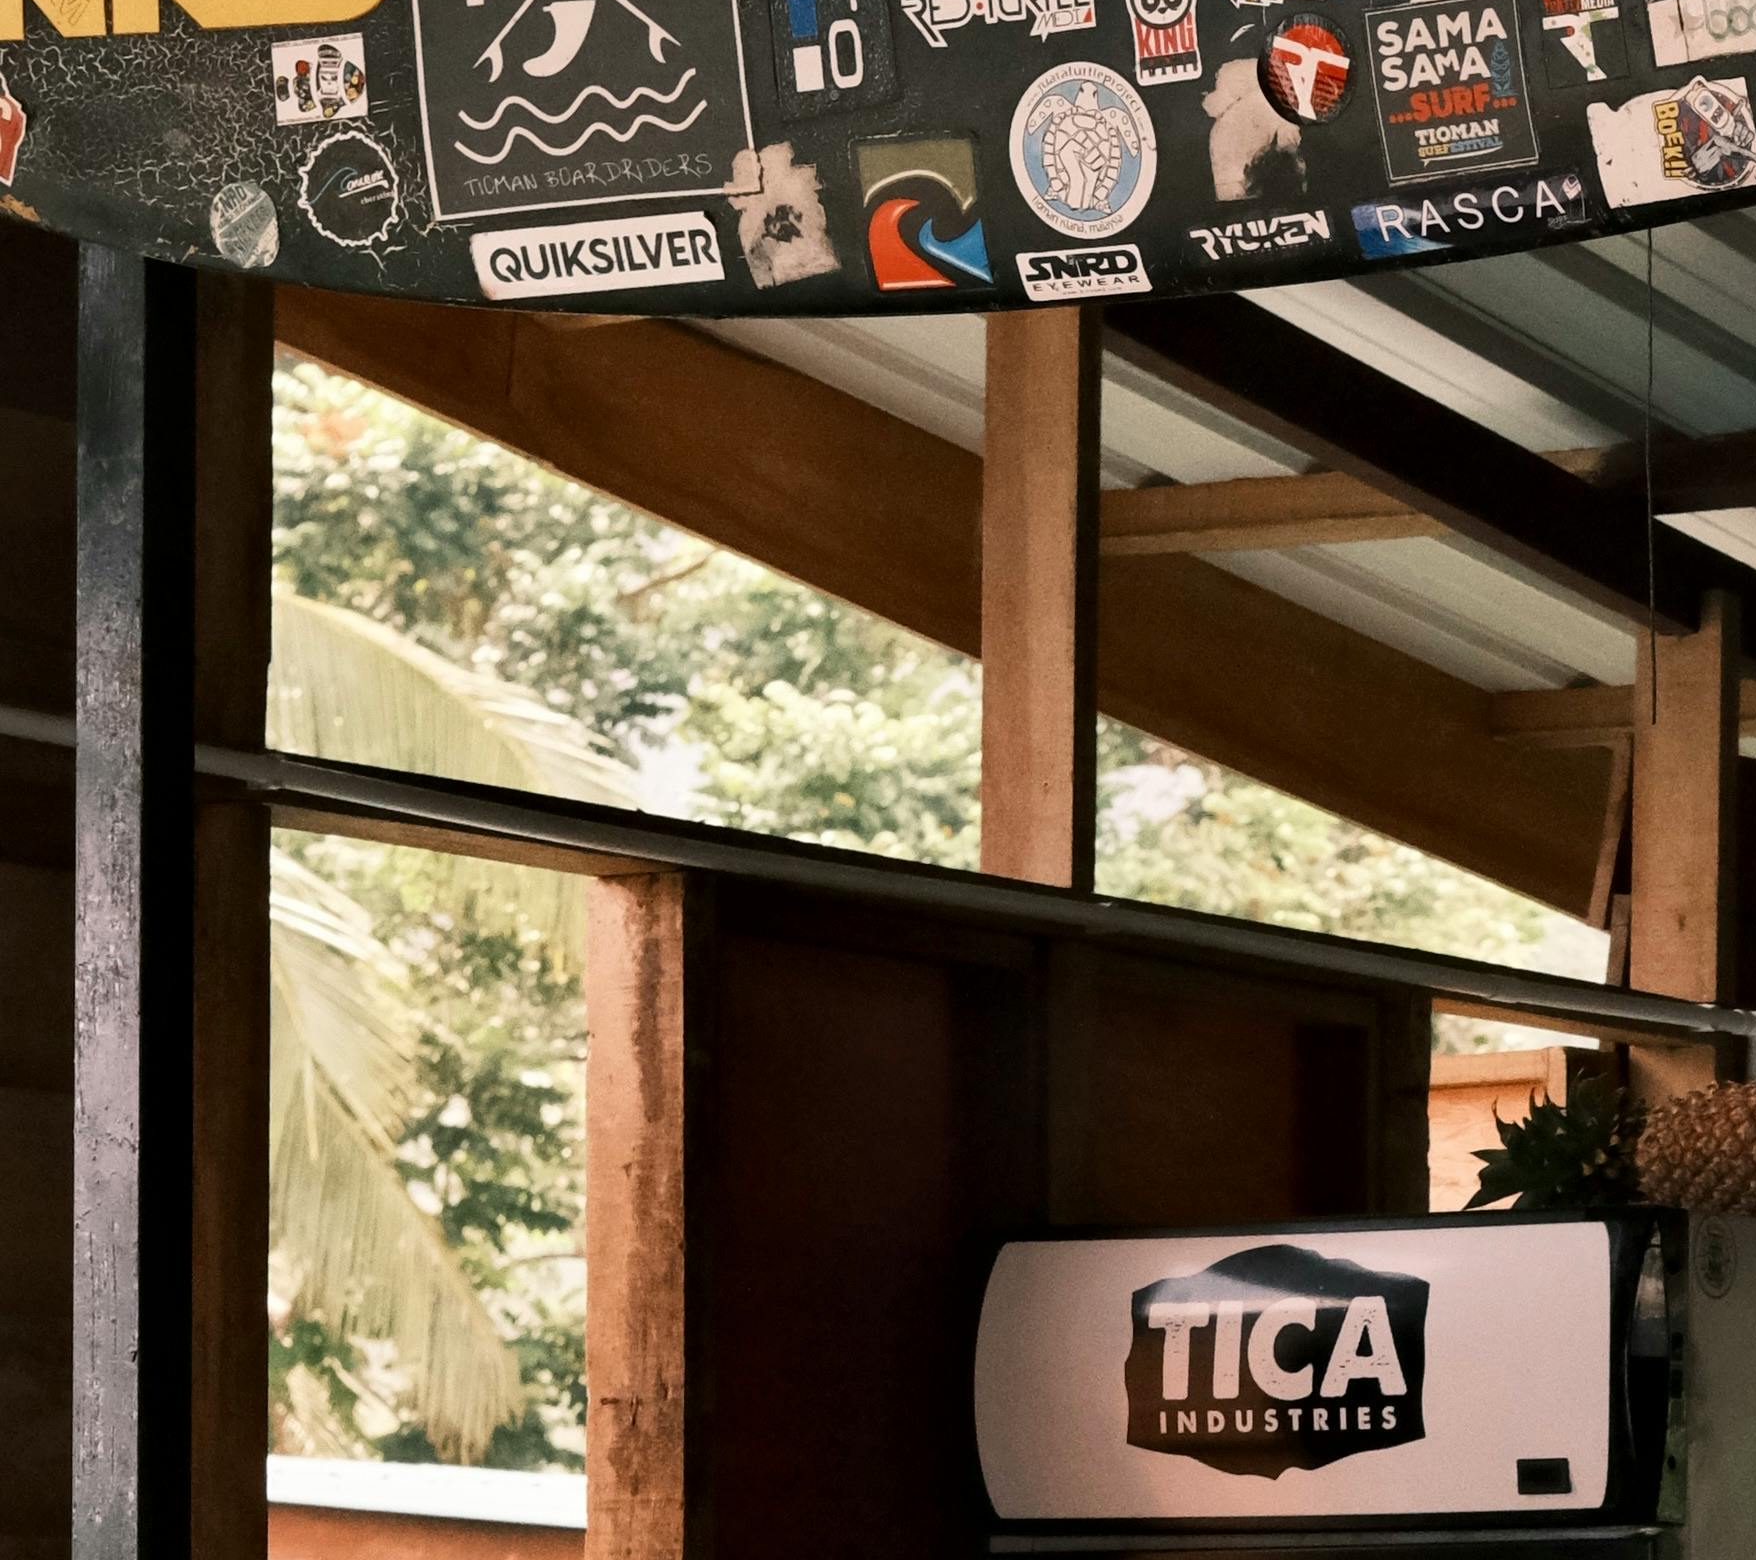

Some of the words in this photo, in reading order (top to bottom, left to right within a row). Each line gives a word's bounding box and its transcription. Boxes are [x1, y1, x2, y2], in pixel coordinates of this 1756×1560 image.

[1135, 11, 1196, 57] KING
[1376, 7, 1508, 57] SAMA
[1381, 46, 1492, 92] SAMA
[1414, 118, 1500, 146] TIOMAN
[543, 153, 713, 188] BOARDRIDERS
[489, 228, 720, 284] QUIKSILVER
[1026, 249, 1138, 282] SNRD
[1032, 274, 1141, 292] EYEWEAR
[1147, 1295, 1409, 1402] TICA
[1159, 1405, 1399, 1436] INDUSTRIES
